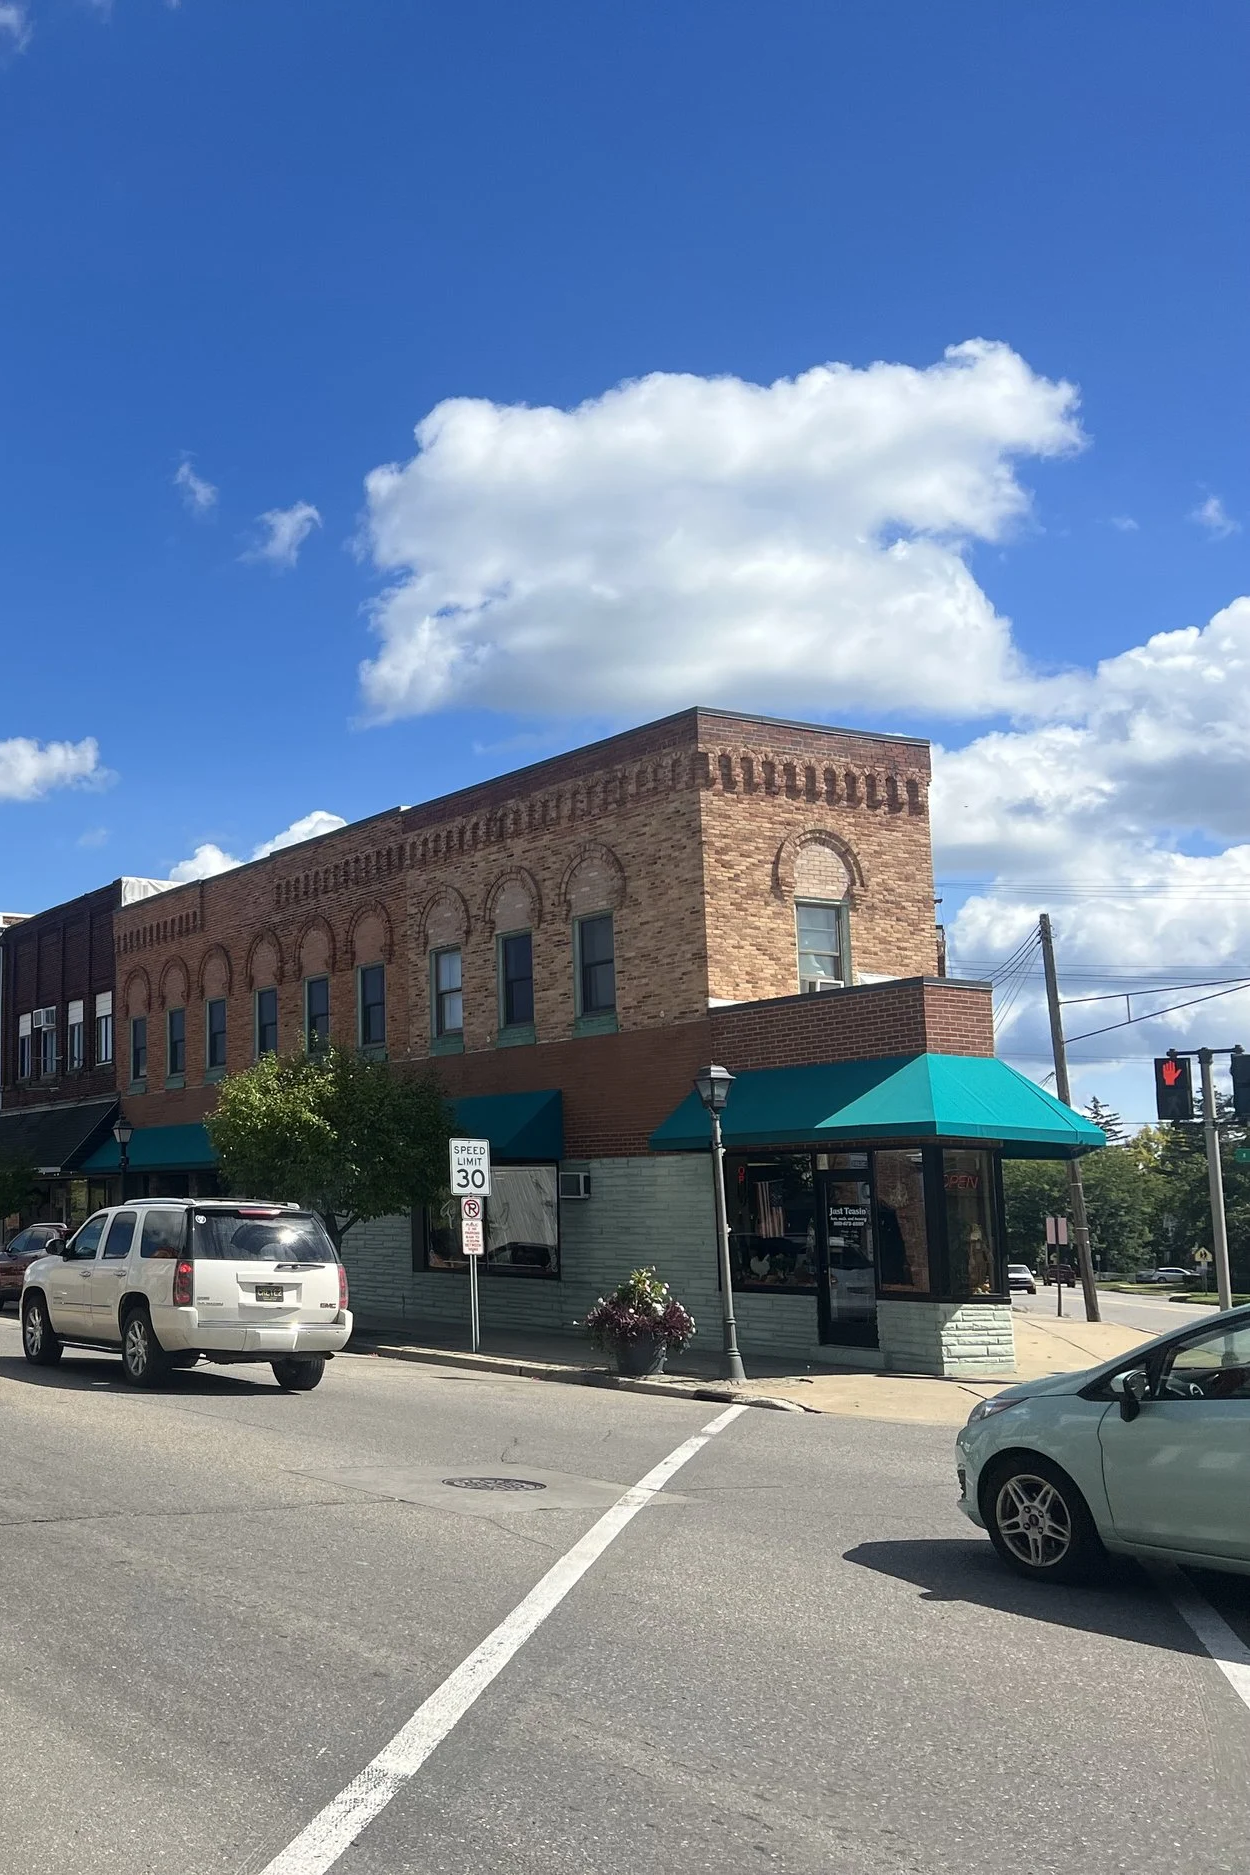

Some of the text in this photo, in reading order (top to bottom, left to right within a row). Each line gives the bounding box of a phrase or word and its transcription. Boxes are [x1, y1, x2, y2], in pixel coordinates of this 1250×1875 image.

[454, 1145, 486, 1155] SPEED
[457, 1157, 483, 1166] LIMIT
[456, 1168, 486, 1189] 30
[829, 1207, 844, 1217] Just
